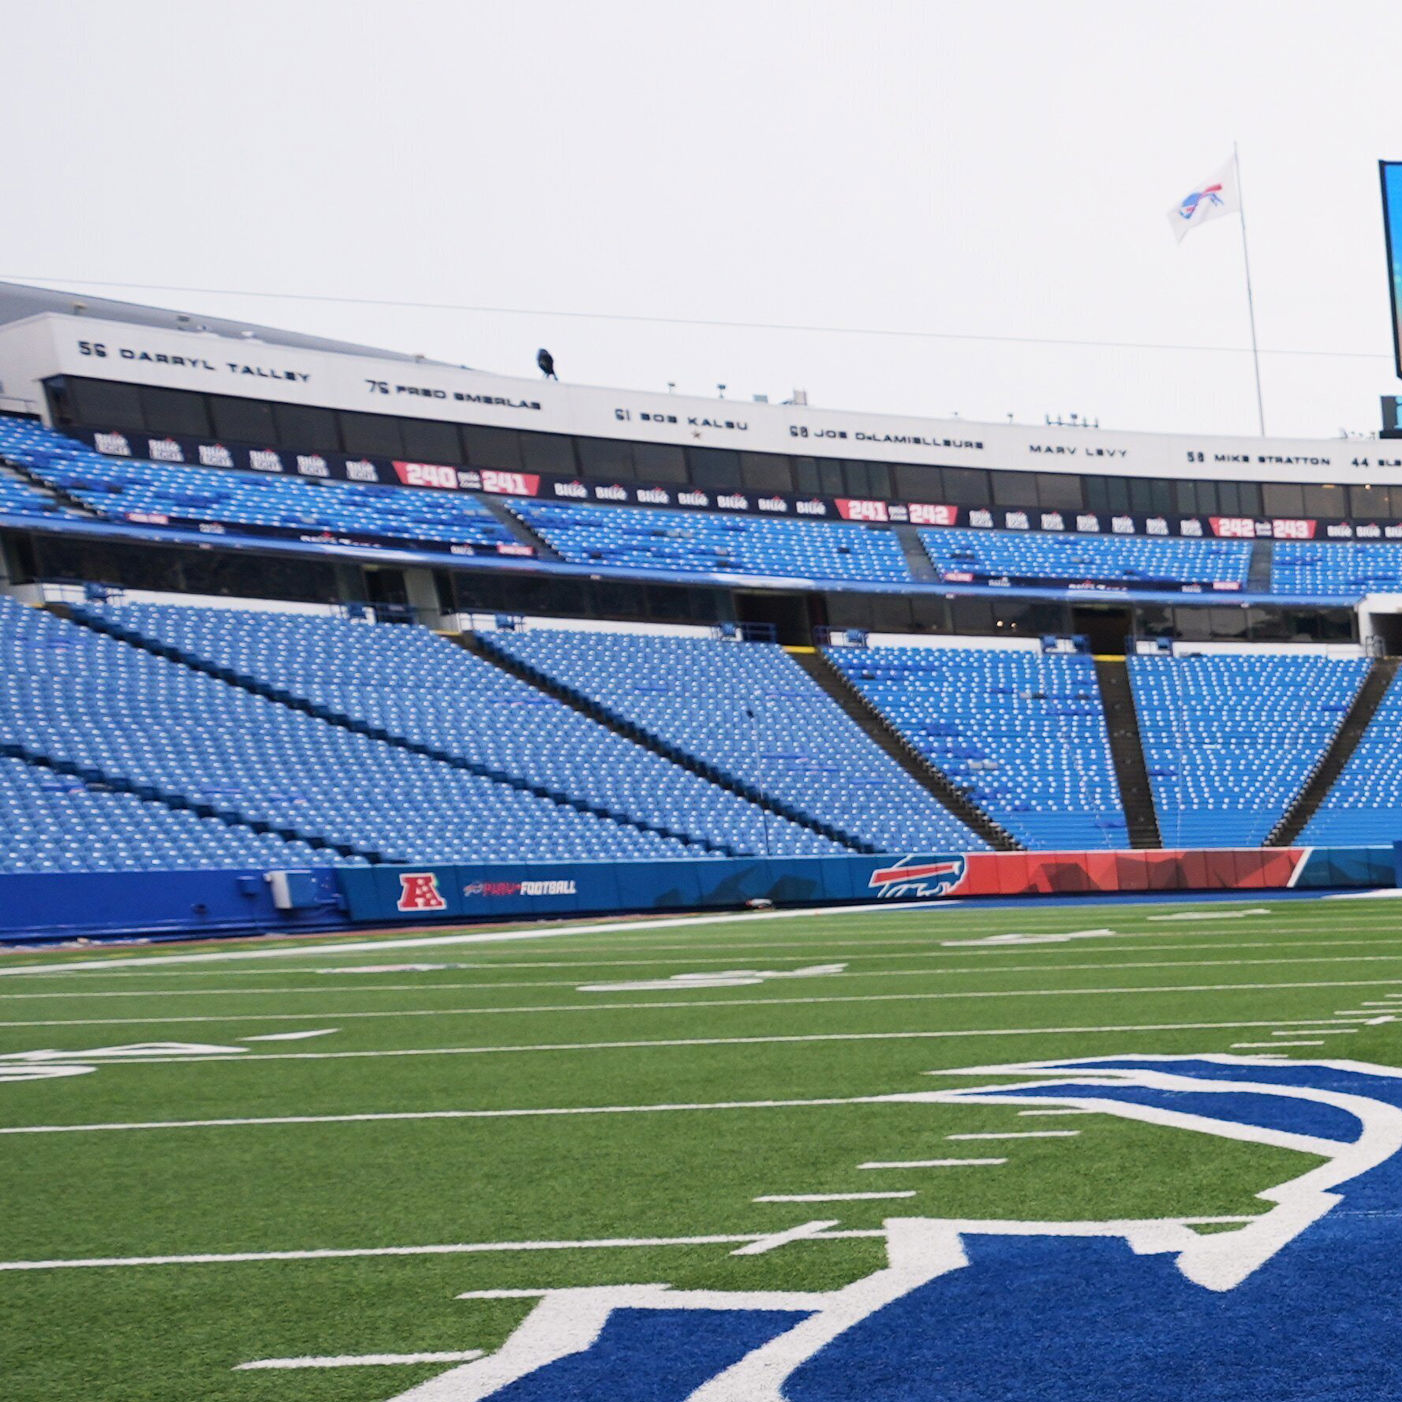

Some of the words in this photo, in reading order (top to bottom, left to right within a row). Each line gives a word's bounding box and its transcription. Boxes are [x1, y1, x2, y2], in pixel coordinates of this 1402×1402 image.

[119, 348, 216, 371] DARRYL
[226, 363, 311, 382] TALLEY
[396, 386, 447, 399] FRED
[454, 393, 542, 411] SMERLAS
[640, 412, 677, 424] BOB
[687, 417, 748, 431] KALSU
[814, 430, 848, 439] JOE
[1029, 444, 1077, 455] MARV
[1086, 447, 1127, 457] LEVY
[1215, 454, 1250, 463] MIKE
[1258, 456, 1331, 466] STRATTON
[1352, 458, 1369, 467] 44
[406, 463, 458, 489] 240
[482, 470, 528, 494] 241
[848, 500, 888, 521] 241
[909, 503, 950, 525] 242
[1218, 518, 1255, 537] 242
[1273, 519, 1309, 539] 243
[520, 880, 577, 896] FOOTBALL
